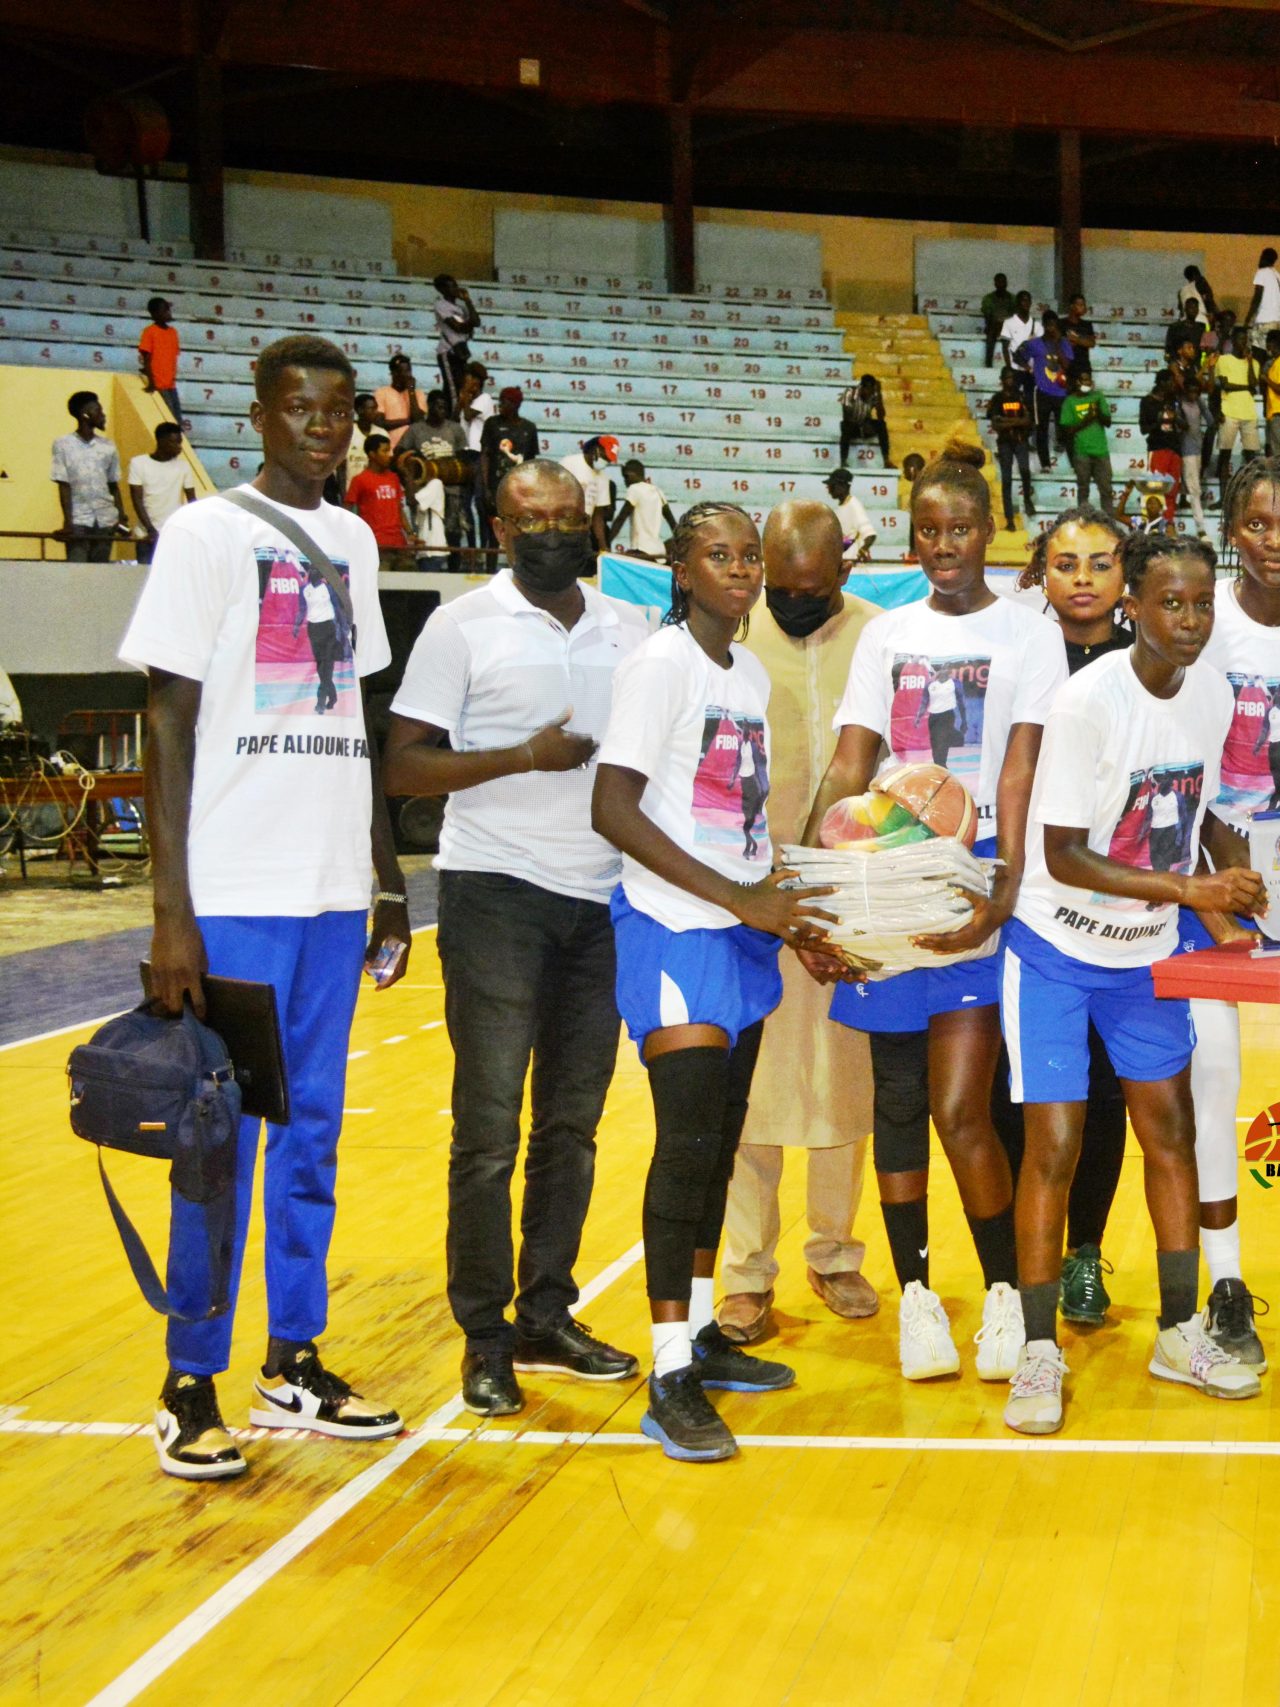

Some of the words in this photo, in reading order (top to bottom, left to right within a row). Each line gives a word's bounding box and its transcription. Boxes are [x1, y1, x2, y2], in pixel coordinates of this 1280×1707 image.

[50, 319, 60, 334] 5
[104, 325, 115, 338] 6
[251, 336, 260, 347] 9
[41, 348, 51, 361] 4
[341, 344, 358, 354] 11
[93, 352, 103, 365] 5
[194, 357, 203, 368] 7
[484, 351, 500, 363] 14
[528, 354, 544, 365] 15
[571, 357, 588, 367] 16
[613, 358, 628, 369] 17
[659, 361, 674, 372] 18
[704, 363, 719, 374] 19
[745, 364, 760, 375] 20
[787, 365, 801, 375] 21
[525, 379, 542, 390] 14
[961, 375, 975, 386] 23
[1118, 380, 1132, 391] 27
[570, 381, 586, 393] 15
[617, 383, 633, 393] 16
[662, 385, 677, 395] 17
[204, 389, 213, 400] 7
[706, 388, 722, 399] 18
[751, 389, 767, 399] 19
[786, 389, 801, 399] 20
[544, 407, 561, 418] 14
[591, 410, 607, 421] 15
[639, 412, 655, 424] 16
[680, 412, 695, 422] 17
[726, 414, 741, 425] 18
[766, 417, 782, 428] 19
[804, 416, 821, 427] 20
[236, 422, 244, 434] 7
[1116, 429, 1131, 439] 25
[630, 442, 646, 454] 15
[676, 444, 693, 456] 16
[723, 447, 740, 457] 17
[766, 448, 782, 459] 18
[814, 448, 830, 459] 19
[858, 450, 874, 462] 20
[229, 457, 240, 470] 6
[684, 478, 702, 489] 15
[732, 480, 749, 492] 16
[780, 481, 795, 491] 17
[872, 485, 888, 496] 19
[881, 516, 897, 527] 15
[271, 577, 299, 594] FIBA
[900, 675, 925, 690] FIBA
[1236, 700, 1265, 717] FIBA
[236, 735, 279, 755] PAPE
[283, 735, 349, 757] ALIOUNE
[715, 734, 739, 751] FIBA
[1053, 906, 1100, 935] PAPE
